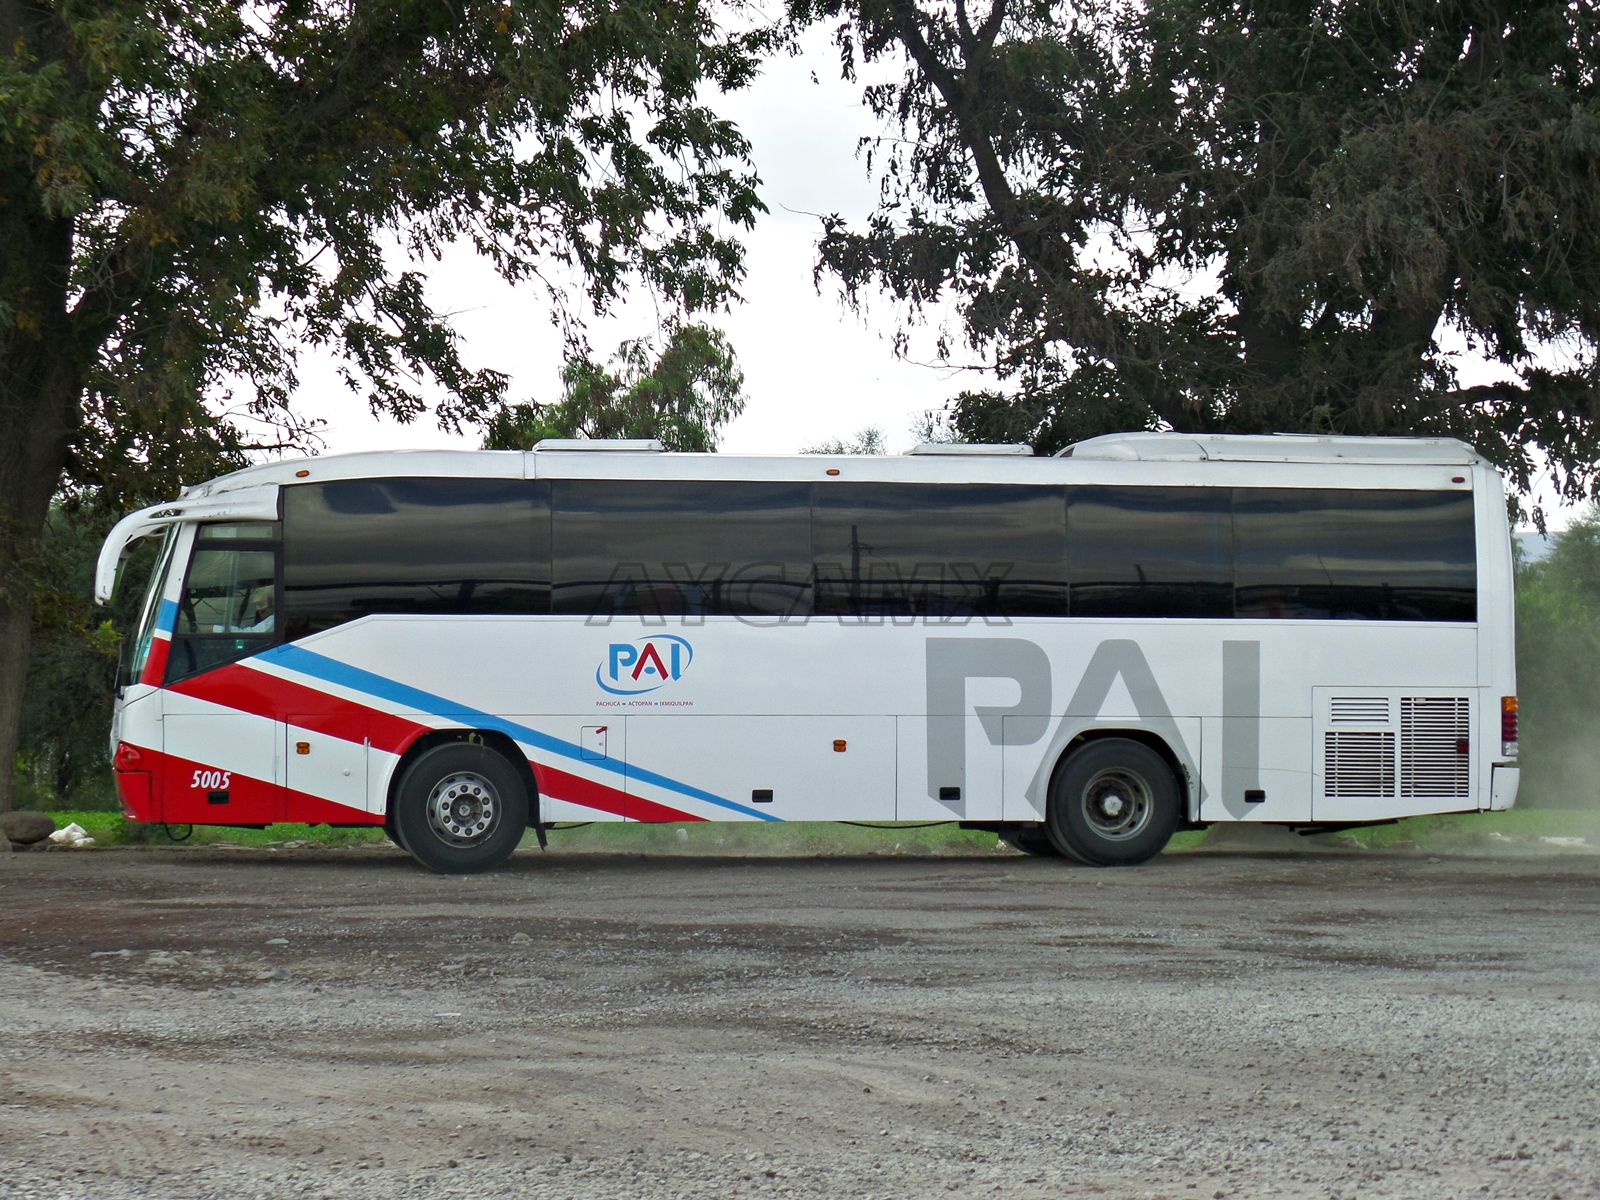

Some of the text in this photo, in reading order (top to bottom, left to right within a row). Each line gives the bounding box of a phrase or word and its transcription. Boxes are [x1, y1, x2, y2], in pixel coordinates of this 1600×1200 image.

[609, 642, 682, 681] PAI
[926, 637, 1260, 821] PAI
[190, 770, 231, 790] 5005
